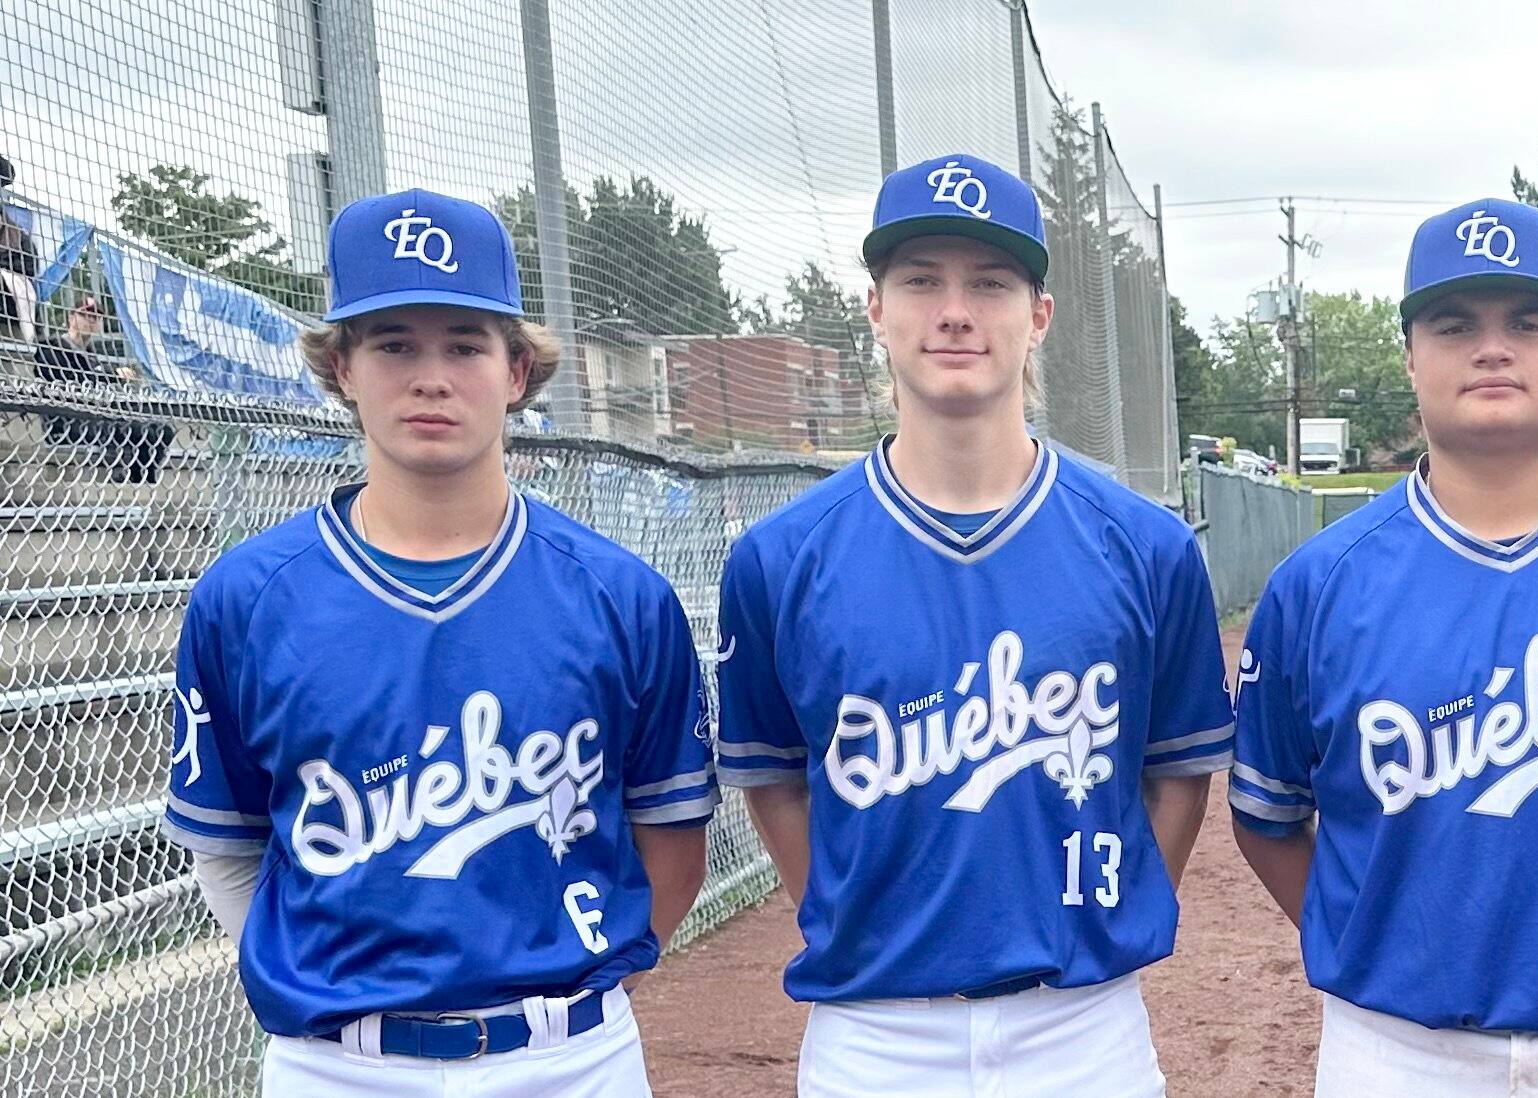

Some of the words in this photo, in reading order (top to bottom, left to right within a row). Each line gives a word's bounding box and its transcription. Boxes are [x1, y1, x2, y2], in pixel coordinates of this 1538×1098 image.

[291, 690, 603, 879] Québec
[824, 629, 1119, 812] Québec
[1062, 830, 1123, 908] 13
